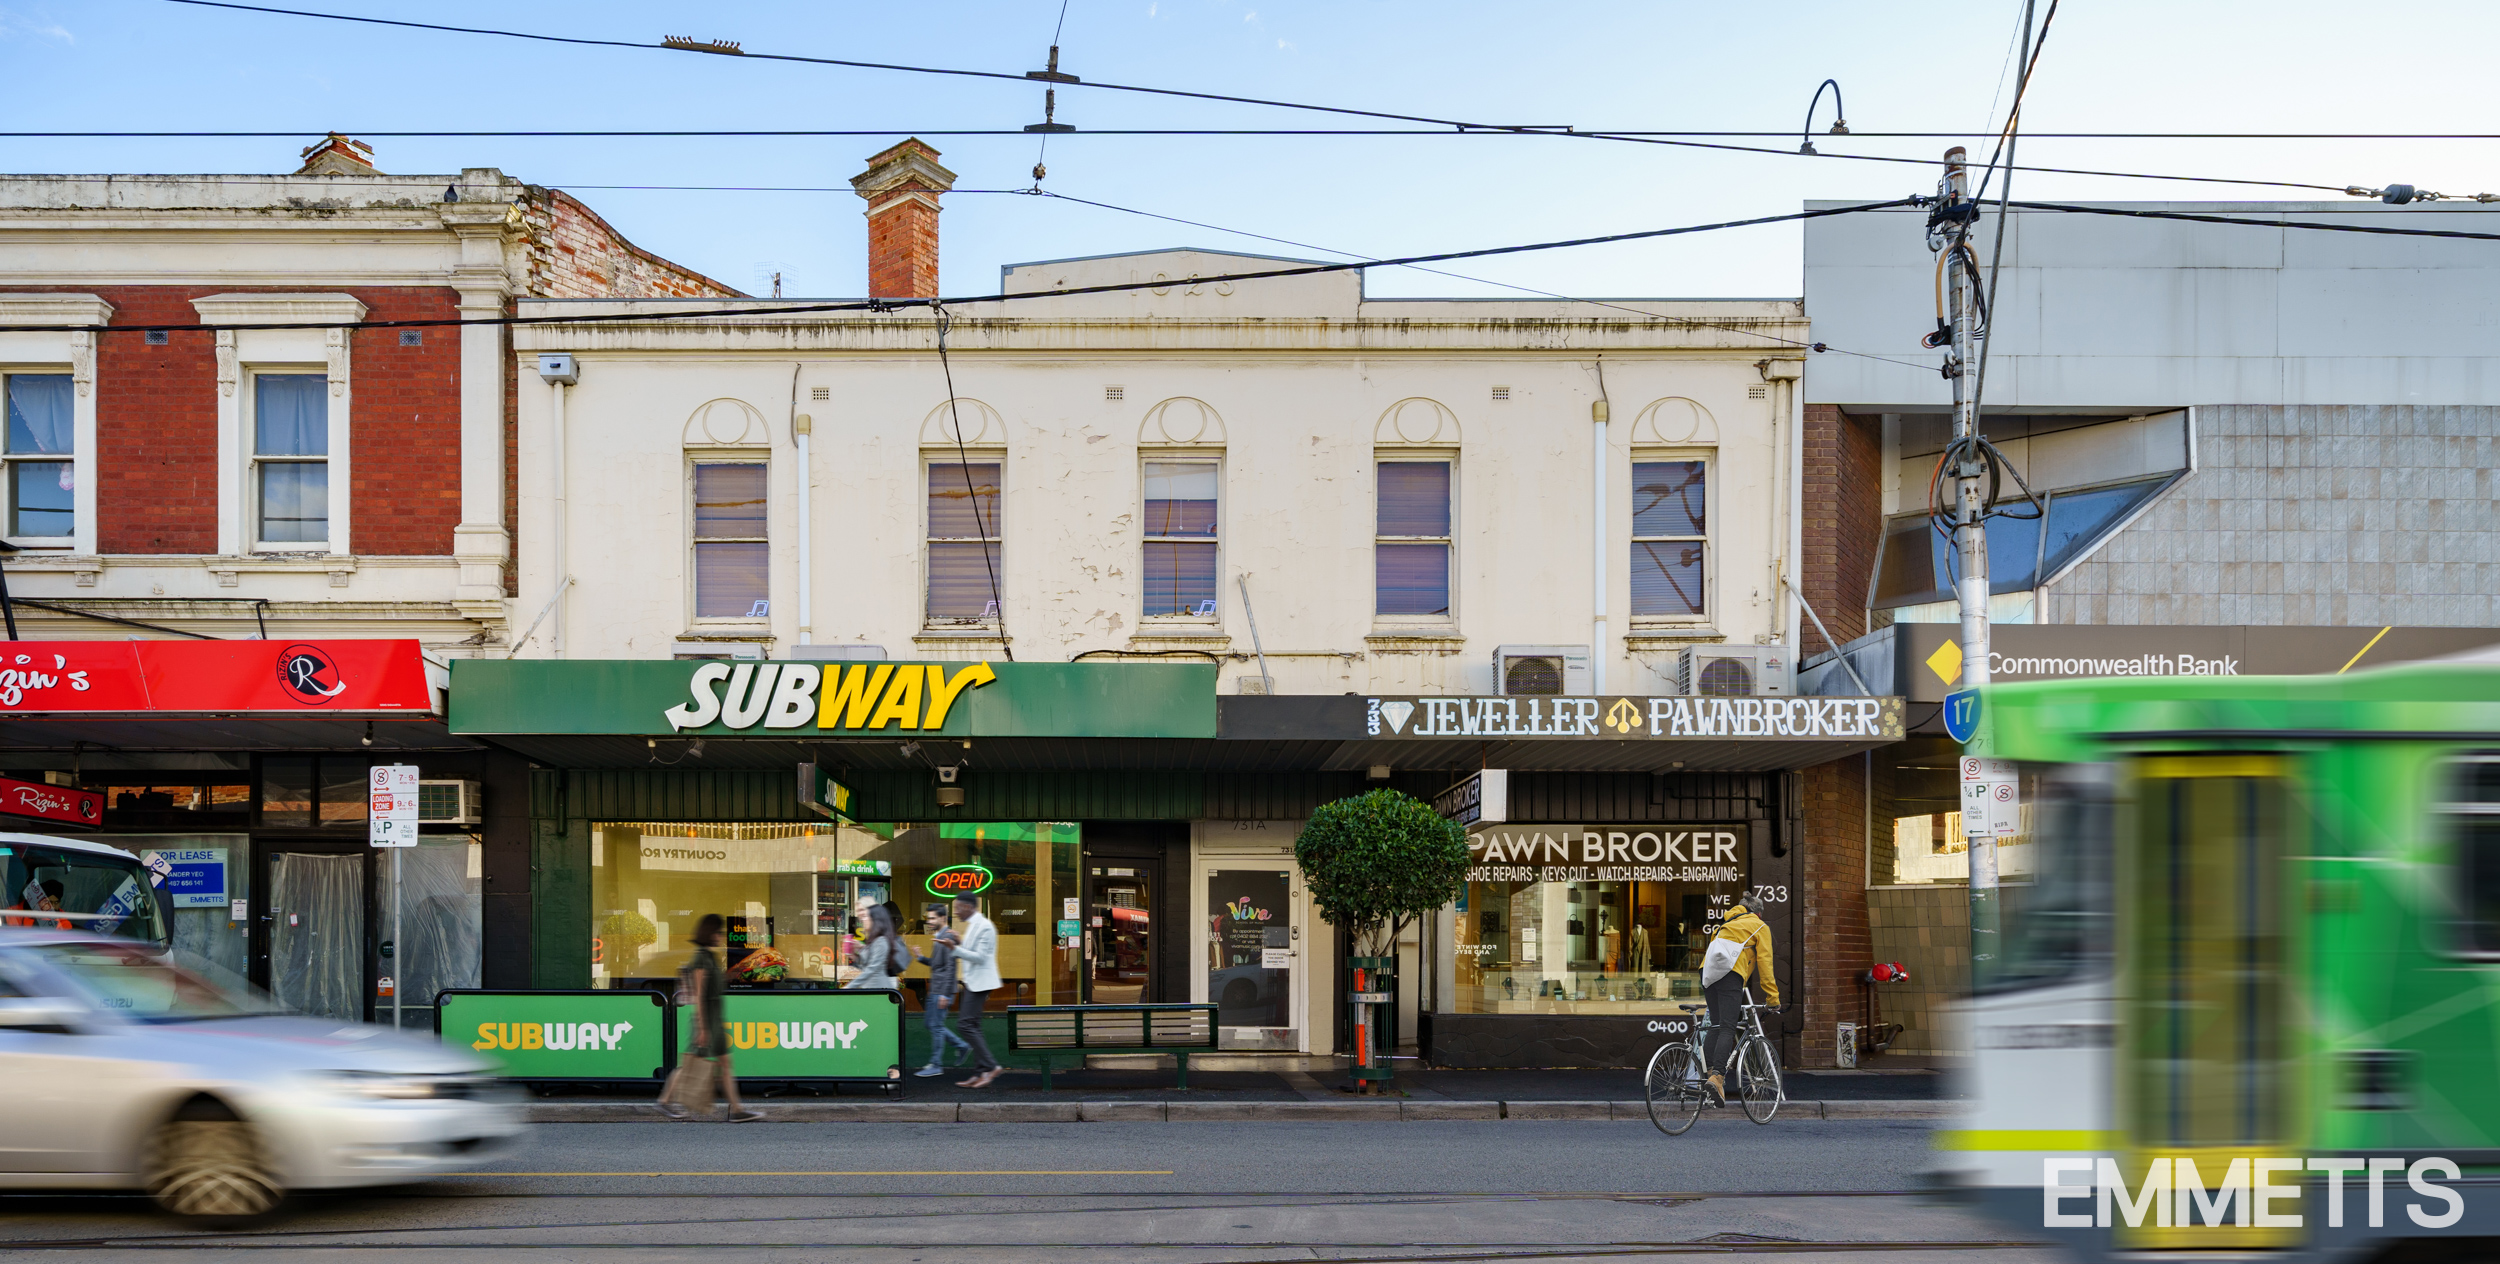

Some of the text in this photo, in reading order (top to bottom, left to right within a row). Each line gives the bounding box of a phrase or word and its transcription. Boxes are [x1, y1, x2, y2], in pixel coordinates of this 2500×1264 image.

[279, 653, 291, 681] RIZIN'S
[1987, 652, 2238, 676] Commonwealth Bank
[0, 654, 90, 706] zin's
[664, 659, 996, 733] SUBWAY
[1413, 698, 1881, 736] JEWELLER PAWNBROKER
[1954, 696, 1975, 726] 17
[13, 786, 70, 813] Rizin's
[373, 795, 393, 803] LOADING
[825, 778, 850, 812] SUBWAY
[1453, 778, 1480, 813] BROKER
[1976, 786, 1986, 798] P
[383, 821, 392, 834] P
[1232, 820, 1267, 830] 731A
[1466, 832, 1738, 862] PAWN BROKER
[157, 851, 214, 860] OR LEASE
[857, 864, 874, 873] drink
[1465, 866, 1491, 882] SHOE
[1493, 866, 1533, 882] REPAIRS
[1541, 866, 1567, 882] KEYS
[1568, 866, 1588, 882] CUT
[1596, 866, 1632, 882] WATCH
[1633, 866, 1673, 882] REPAIRS
[1682, 866, 1738, 882] ENGRAVING
[934, 873, 984, 889] OPEN
[1710, 894, 1731, 905] WE
[1754, 885, 1788, 902] 733
[1226, 896, 1272, 920] Viva
[1707, 909, 1727, 919] BU
[93, 902, 124, 934] ASED
[733, 925, 757, 933] that's
[729, 932, 772, 944] footlong
[743, 941, 766, 949] value
[1647, 1020, 1688, 1034] 0400
[471, 1020, 634, 1052] SUBWAY
